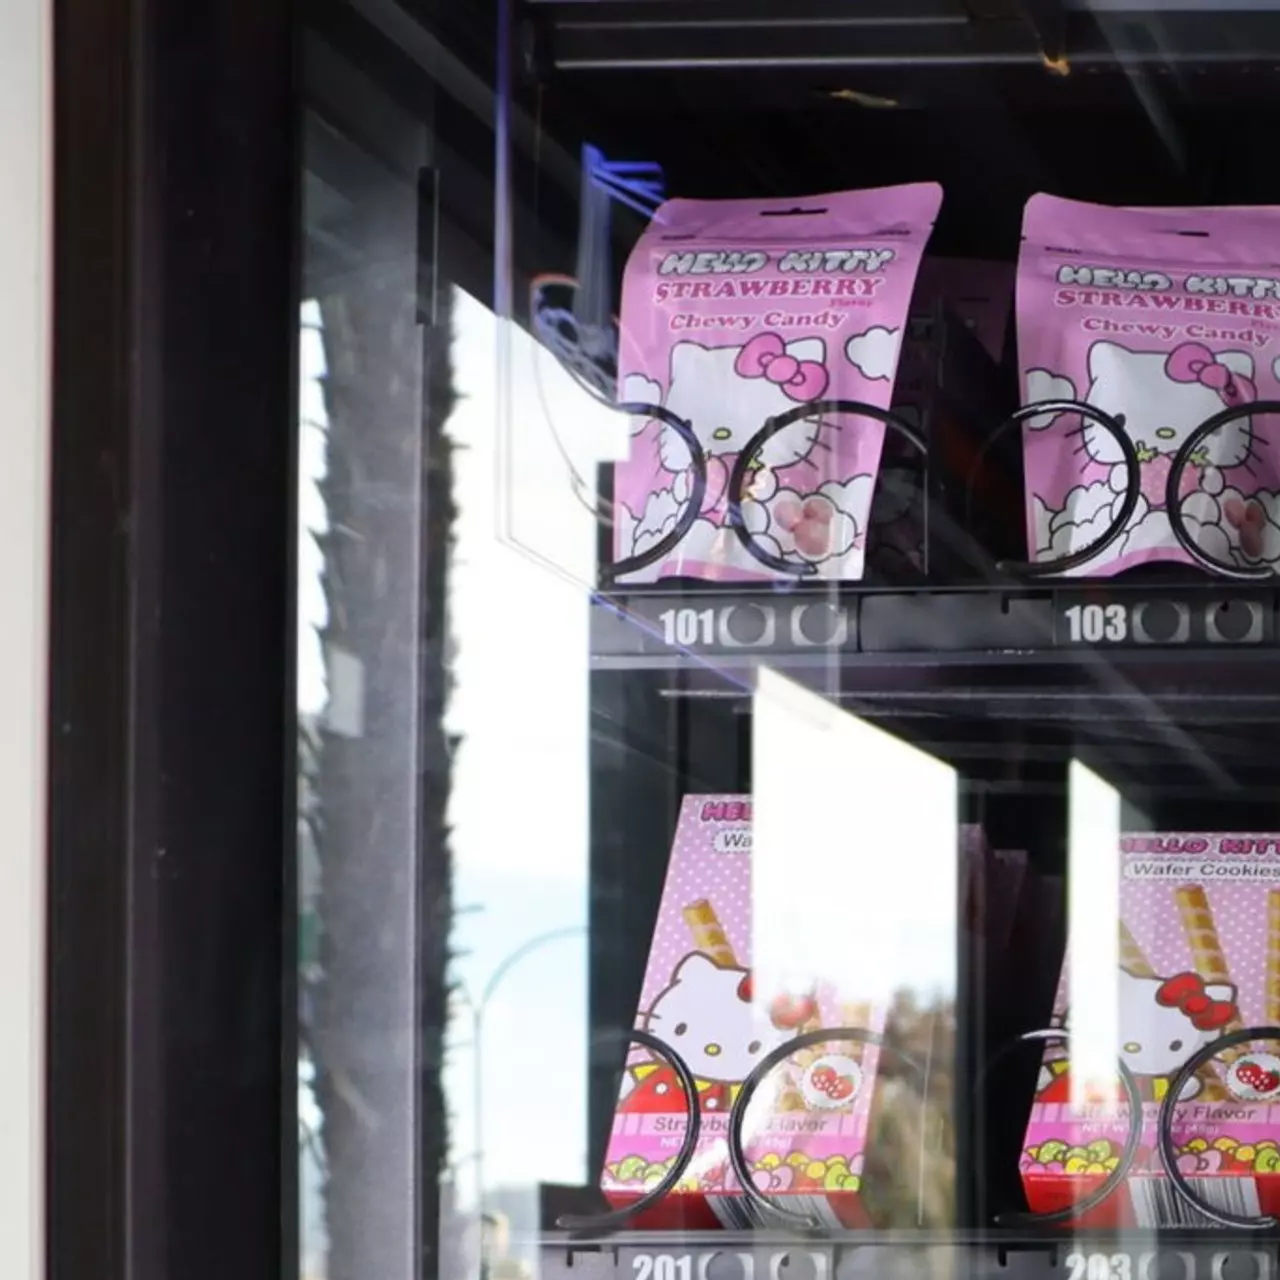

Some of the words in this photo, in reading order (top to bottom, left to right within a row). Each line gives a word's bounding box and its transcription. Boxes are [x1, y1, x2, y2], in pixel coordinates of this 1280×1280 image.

[658, 251, 767, 276] HELLO
[778, 249, 896, 274] KITTY
[1056, 266, 1173, 291] HELLO
[655, 279, 882, 304] STRAWBERRY
[668, 314, 755, 332] Chewy
[763, 311, 847, 330] Candy
[1082, 317, 1176, 339] Chewy
[1186, 325, 1272, 347] Candy
[660, 609, 713, 646] 101
[1065, 604, 1128, 643] 103
[1133, 862, 1195, 878] Wafer
[1193, 1105, 1257, 1121] Flavor
